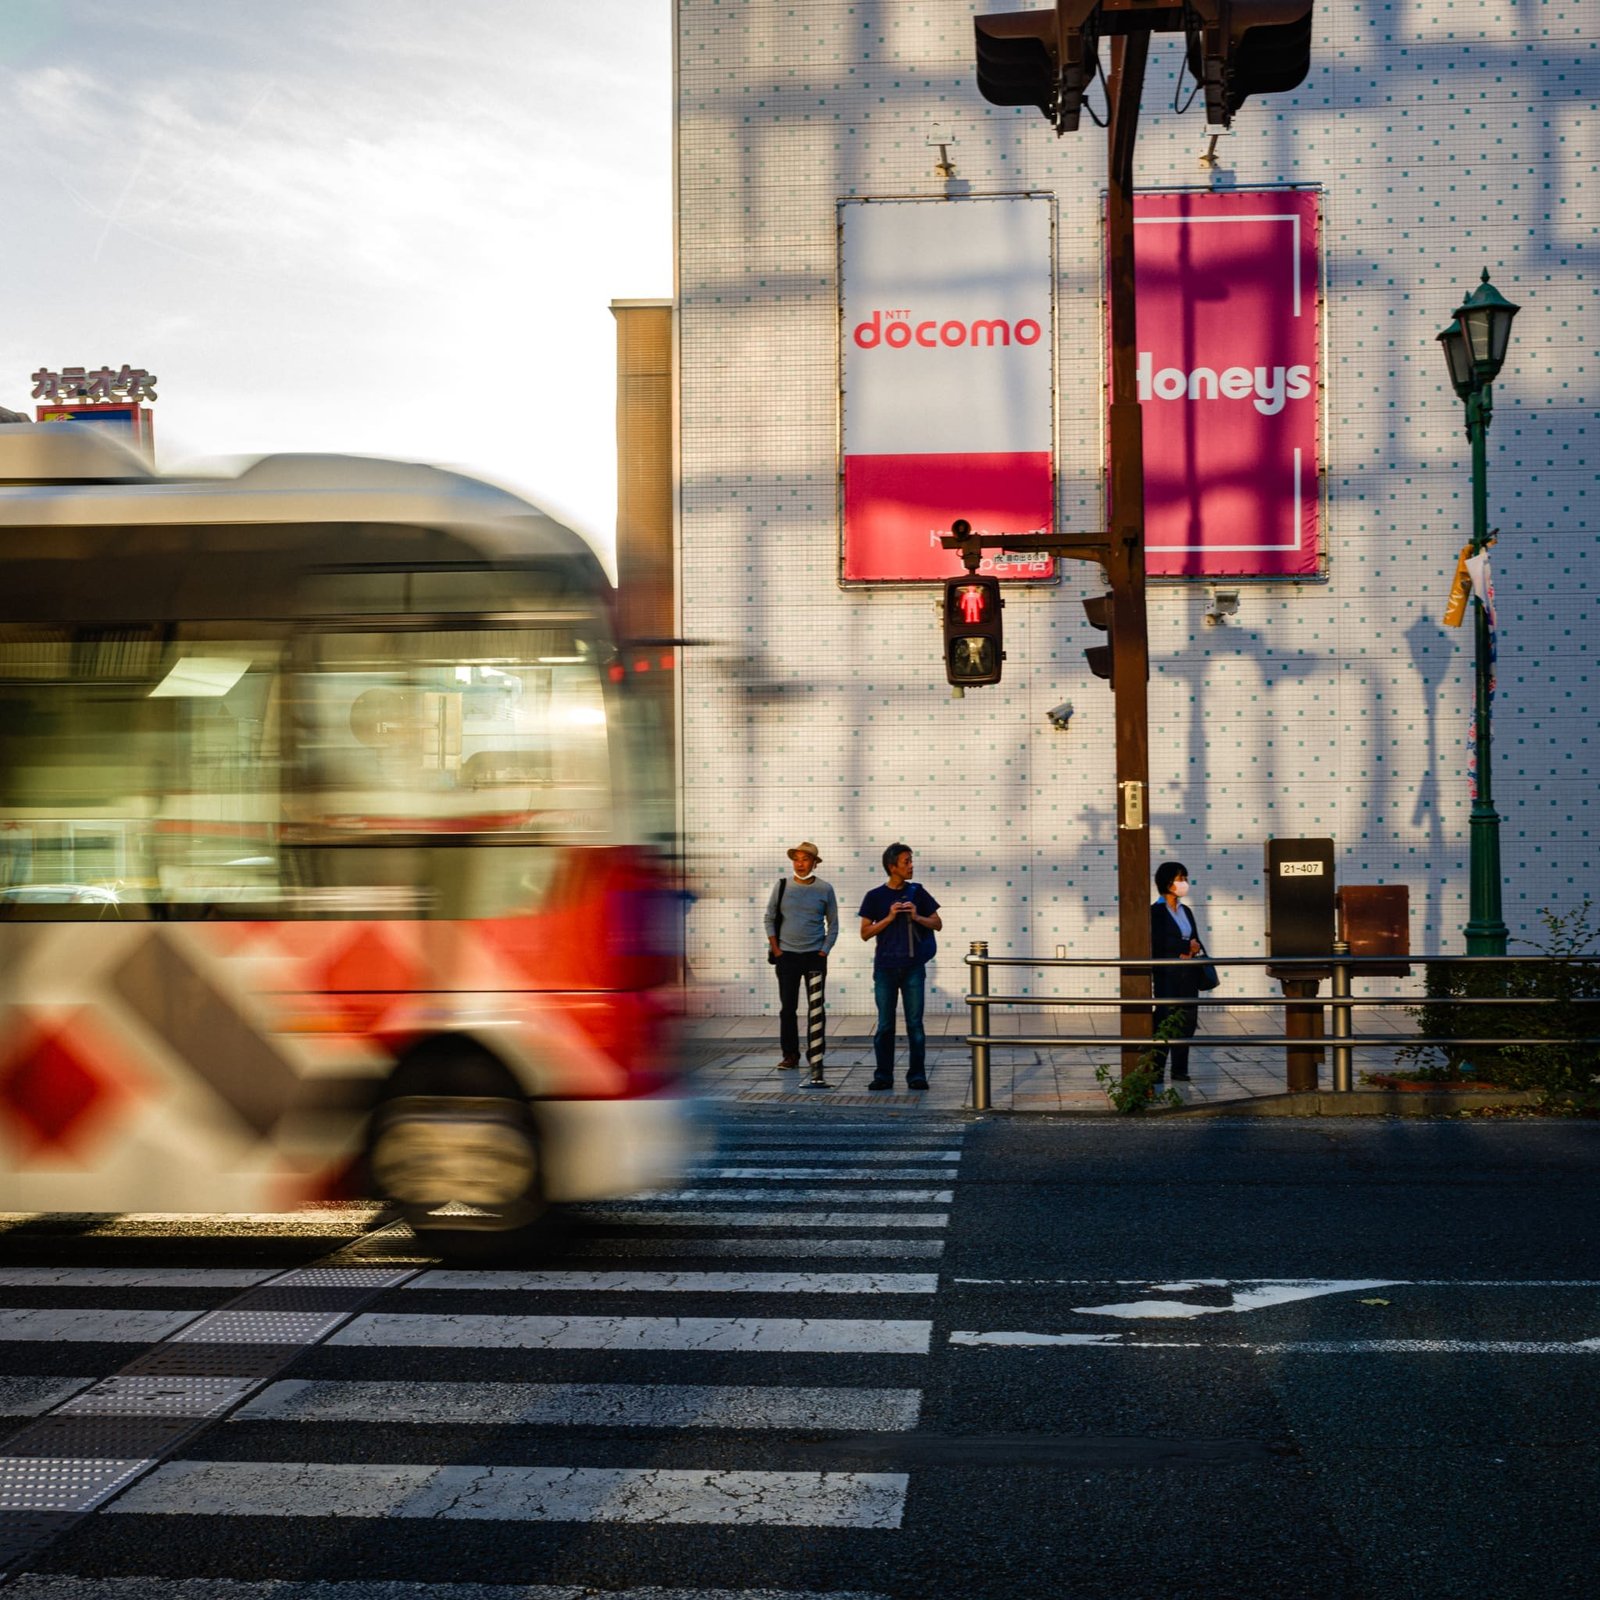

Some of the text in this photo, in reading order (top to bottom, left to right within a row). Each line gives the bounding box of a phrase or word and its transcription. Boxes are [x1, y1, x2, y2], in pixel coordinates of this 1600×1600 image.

[885, 310, 911, 319] NTT
[853, 310, 1041, 349] docomo
[31, 364, 148, 399] カラオケ
[1284, 864, 1319, 873] 21-407
